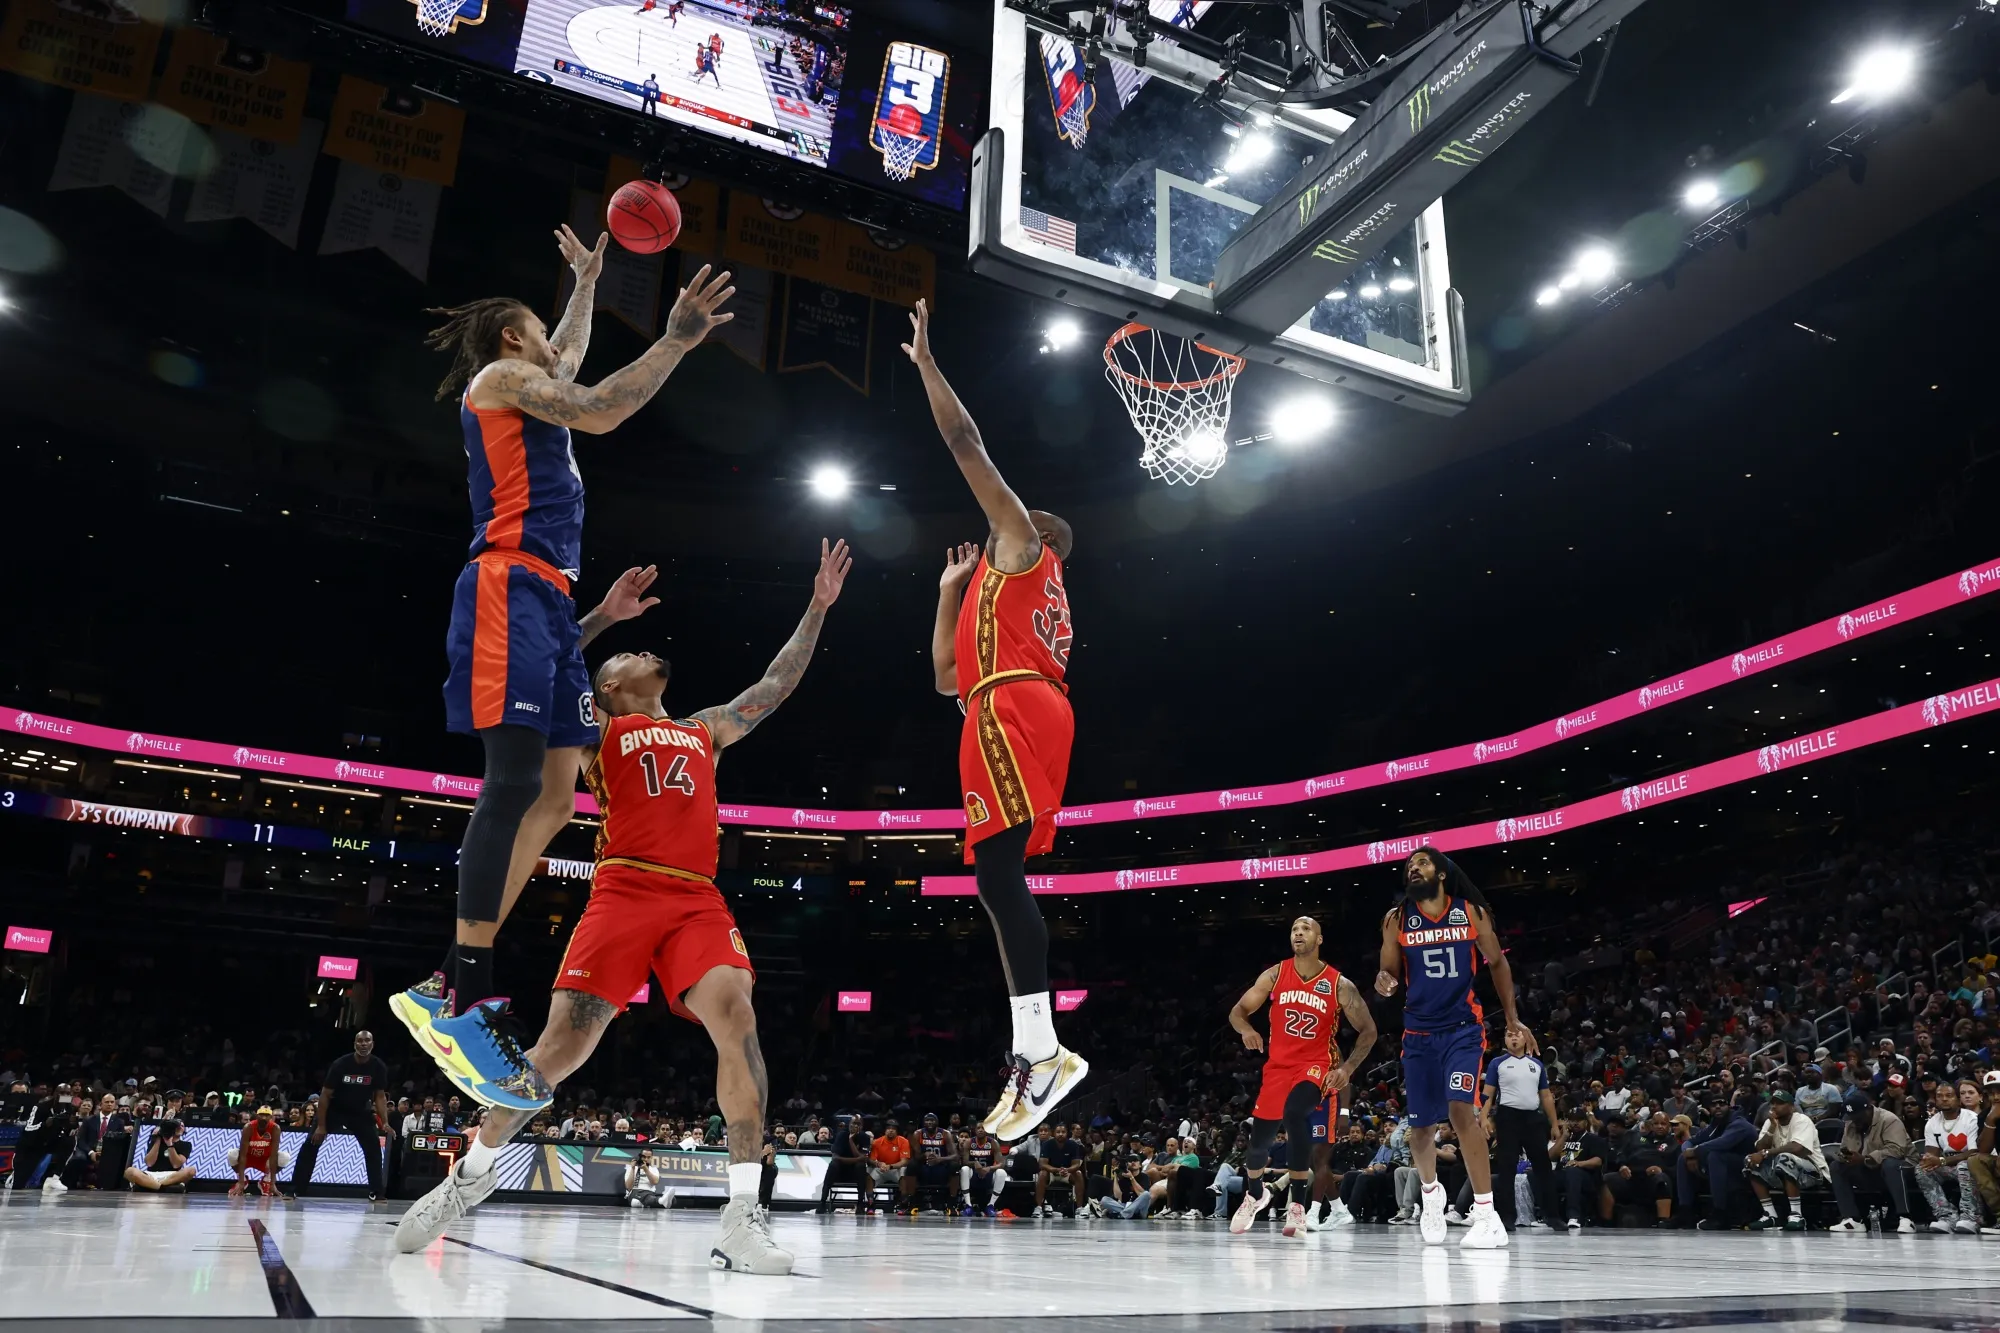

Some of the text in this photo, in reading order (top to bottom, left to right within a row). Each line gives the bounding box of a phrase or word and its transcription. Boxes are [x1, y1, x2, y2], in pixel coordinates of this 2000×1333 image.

[890, 44, 945, 78] BIG
[1430, 40, 1487, 95] MONSTER
[592, 72, 624, 86] COMPANY
[889, 65, 935, 114] 3
[740, 119, 748, 128] 21
[1466, 92, 1531, 144] MONSTER
[742, 216, 820, 246] STANLEY CUP
[1340, 202, 1398, 244] MONSTER
[740, 230, 820, 262] CHAMPIONS
[1855, 603, 1897, 627] MIELLE
[1747, 644, 1784, 666] MIELLE
[1652, 680, 1685, 699] MIELLE
[515, 702, 540, 713] BIG3
[578, 692, 600, 727] 3
[33, 719, 73, 735] MIELLE
[1568, 711, 1597, 729] MIELLE
[144, 738, 182, 752] MIELLE
[620, 727, 706, 758] BIVOUAC
[1488, 738, 1518, 754] MIELLE
[1782, 731, 1837, 760] MIELLE
[250, 753, 286, 766] MIELLE
[1399, 758, 1430, 772] MIELLE
[350, 766, 385, 779] MIELLE
[640, 752, 695, 796] 14
[447, 780, 480, 792] MIELLE
[1317, 776, 1346, 790] MIELLE
[1642, 776, 1688, 800] MIELLE
[2, 792, 15, 808] 3
[1146, 800, 1176, 811] MIELLE
[1232, 792, 1263, 802] MIELLE
[78, 804, 178, 832] 3's COMPANY
[718, 808, 749, 818] MIELLE
[806, 814, 836, 824] MIELLE
[892, 814, 922, 822] MIELLE
[1064, 810, 1093, 819] MIELLE
[1518, 812, 1563, 832] MIELLE
[254, 823, 274, 844] 11
[332, 837, 396, 858] HALF 1
[1262, 858, 1308, 872] MIELLE
[754, 876, 802, 892] FOULS 4
[1025, 878, 1054, 888] ELLE
[1134, 868, 1178, 883] MIELLE
[1406, 926, 1468, 945] COMPANY
[1423, 946, 1459, 978] 51
[567, 969, 590, 978] BIG3
[1280, 990, 1328, 1014] BIVOUAC
[1284, 1009, 1318, 1039] 22
[651, 1156, 702, 1172] OSTON
